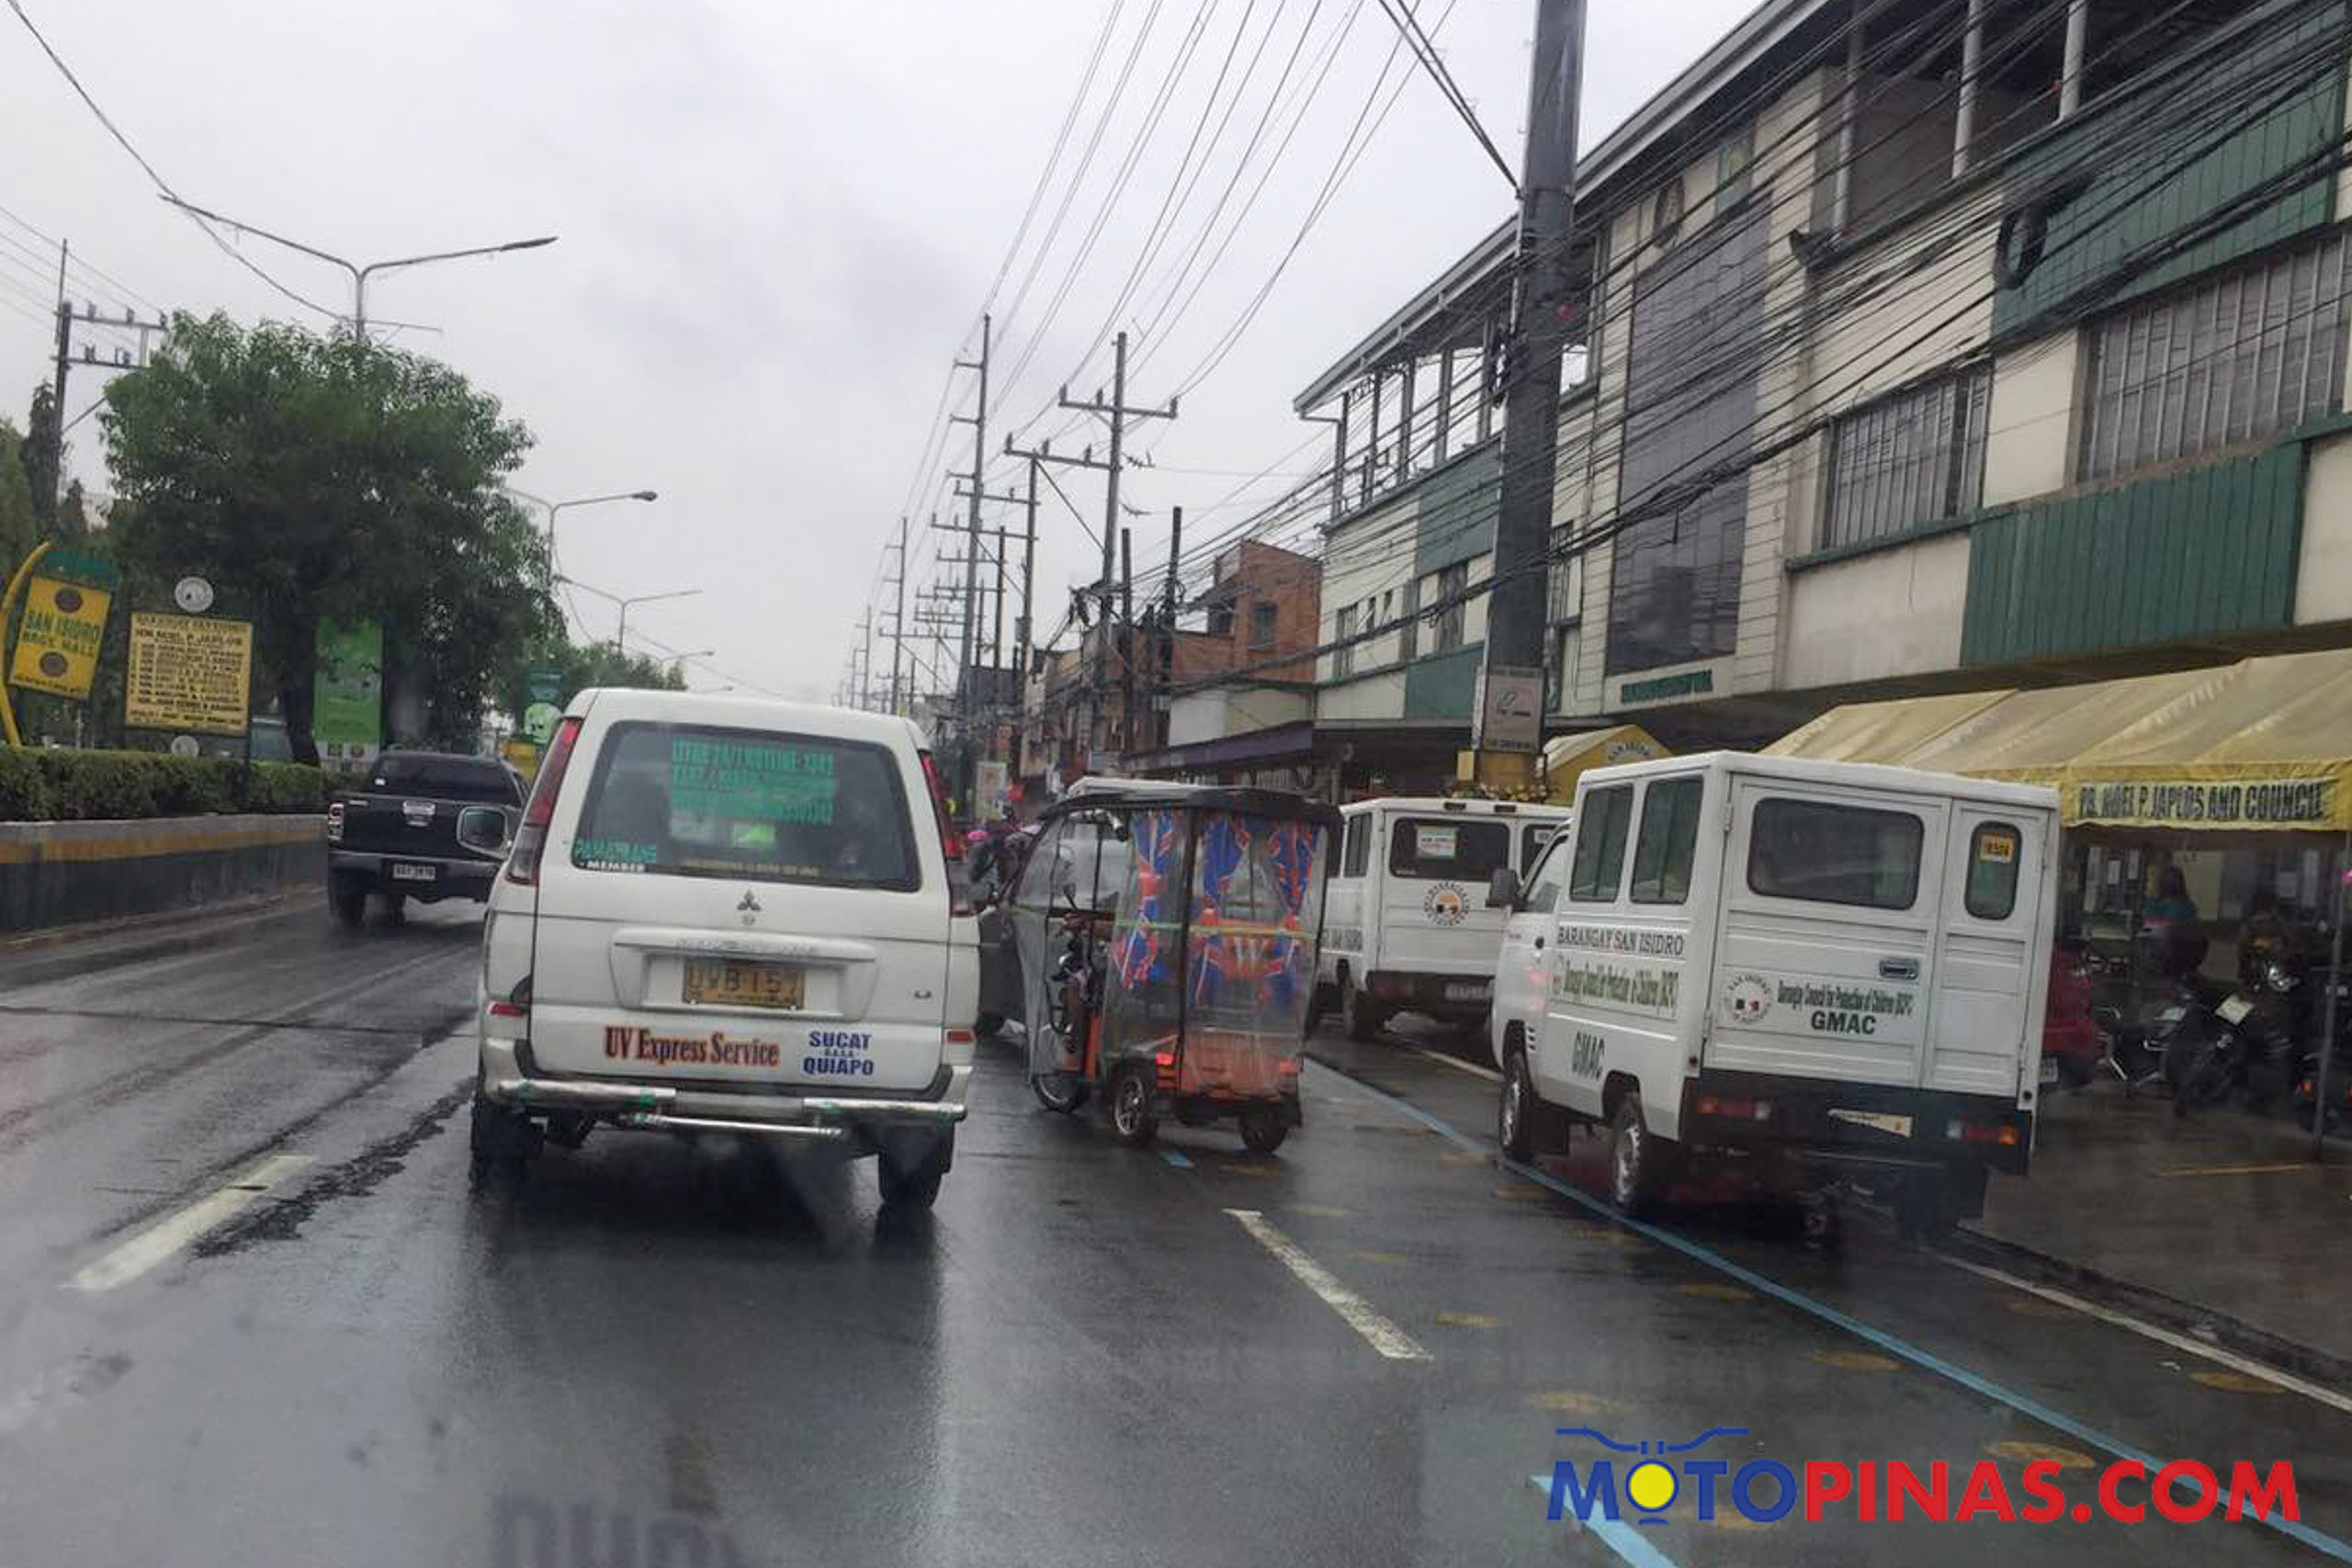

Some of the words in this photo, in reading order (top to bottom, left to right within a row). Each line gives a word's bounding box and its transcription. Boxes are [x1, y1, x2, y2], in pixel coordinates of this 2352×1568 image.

[2207, 784, 2242, 821] AND
[2245, 782, 2324, 821] COUNCIL
[1556, 926, 1612, 949] BARANGAY
[1613, 929, 1637, 952] SAN
[1639, 931, 1685, 956] ISIDRO
[1811, 1010, 1876, 1034] GMAC
[605, 1026, 634, 1057] UV
[639, 1029, 707, 1066] Express
[710, 1031, 780, 1066] Service
[808, 1030, 872, 1050] SUCAT
[803, 1056, 875, 1076] QUIAPO
[1572, 1031, 1605, 1081] GMAC
